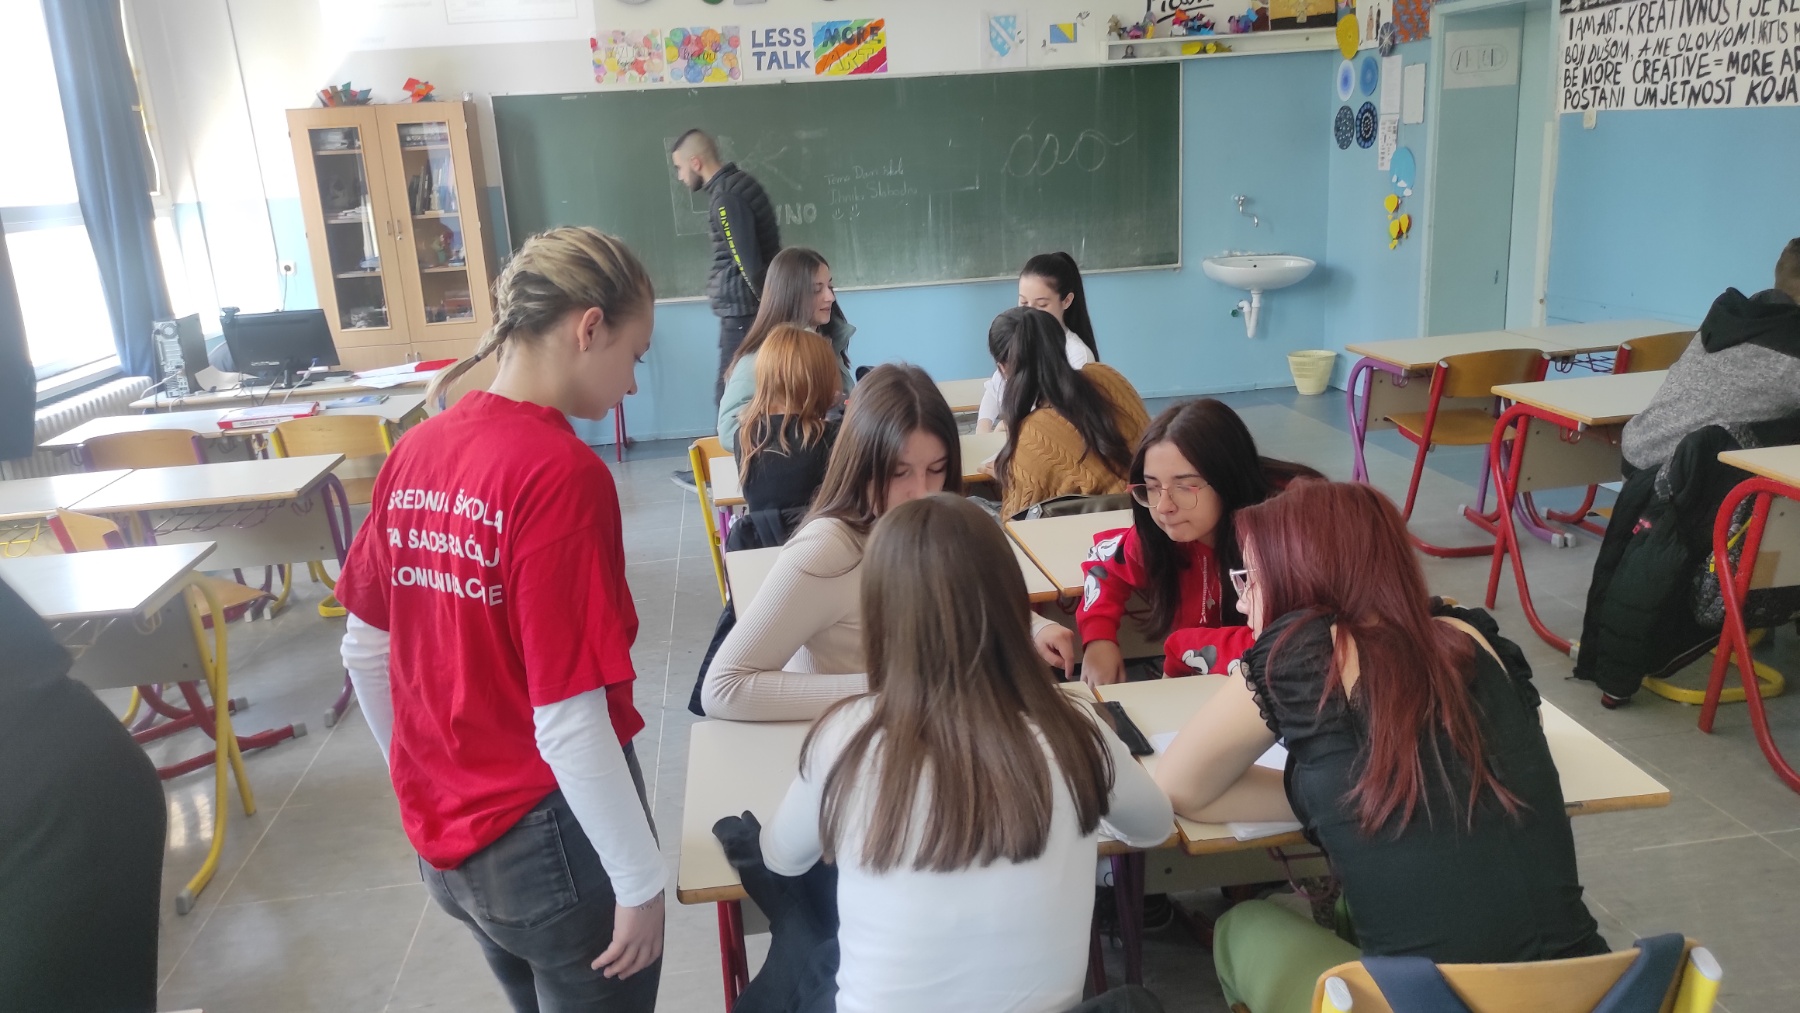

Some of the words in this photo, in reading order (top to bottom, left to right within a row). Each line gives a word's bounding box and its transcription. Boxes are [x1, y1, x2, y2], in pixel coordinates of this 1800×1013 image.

[752, 28, 806, 49] LESS
[822, 26, 882, 48] MORE
[1653, 37, 1674, 57] NE
[752, 51, 811, 71] TALK
[823, 48, 875, 71] ART
[1564, 66, 1580, 88] BE
[1581, 61, 1623, 89] MORE
[1632, 53, 1712, 85] CREATIVE
[1726, 49, 1776, 77] MORE
[1564, 86, 1625, 110] POSTANI
[1634, 76, 1736, 109] UMJETNOST
[1745, 73, 1799, 106] KOJA
[453, 488, 503, 534] ŠKOLA
